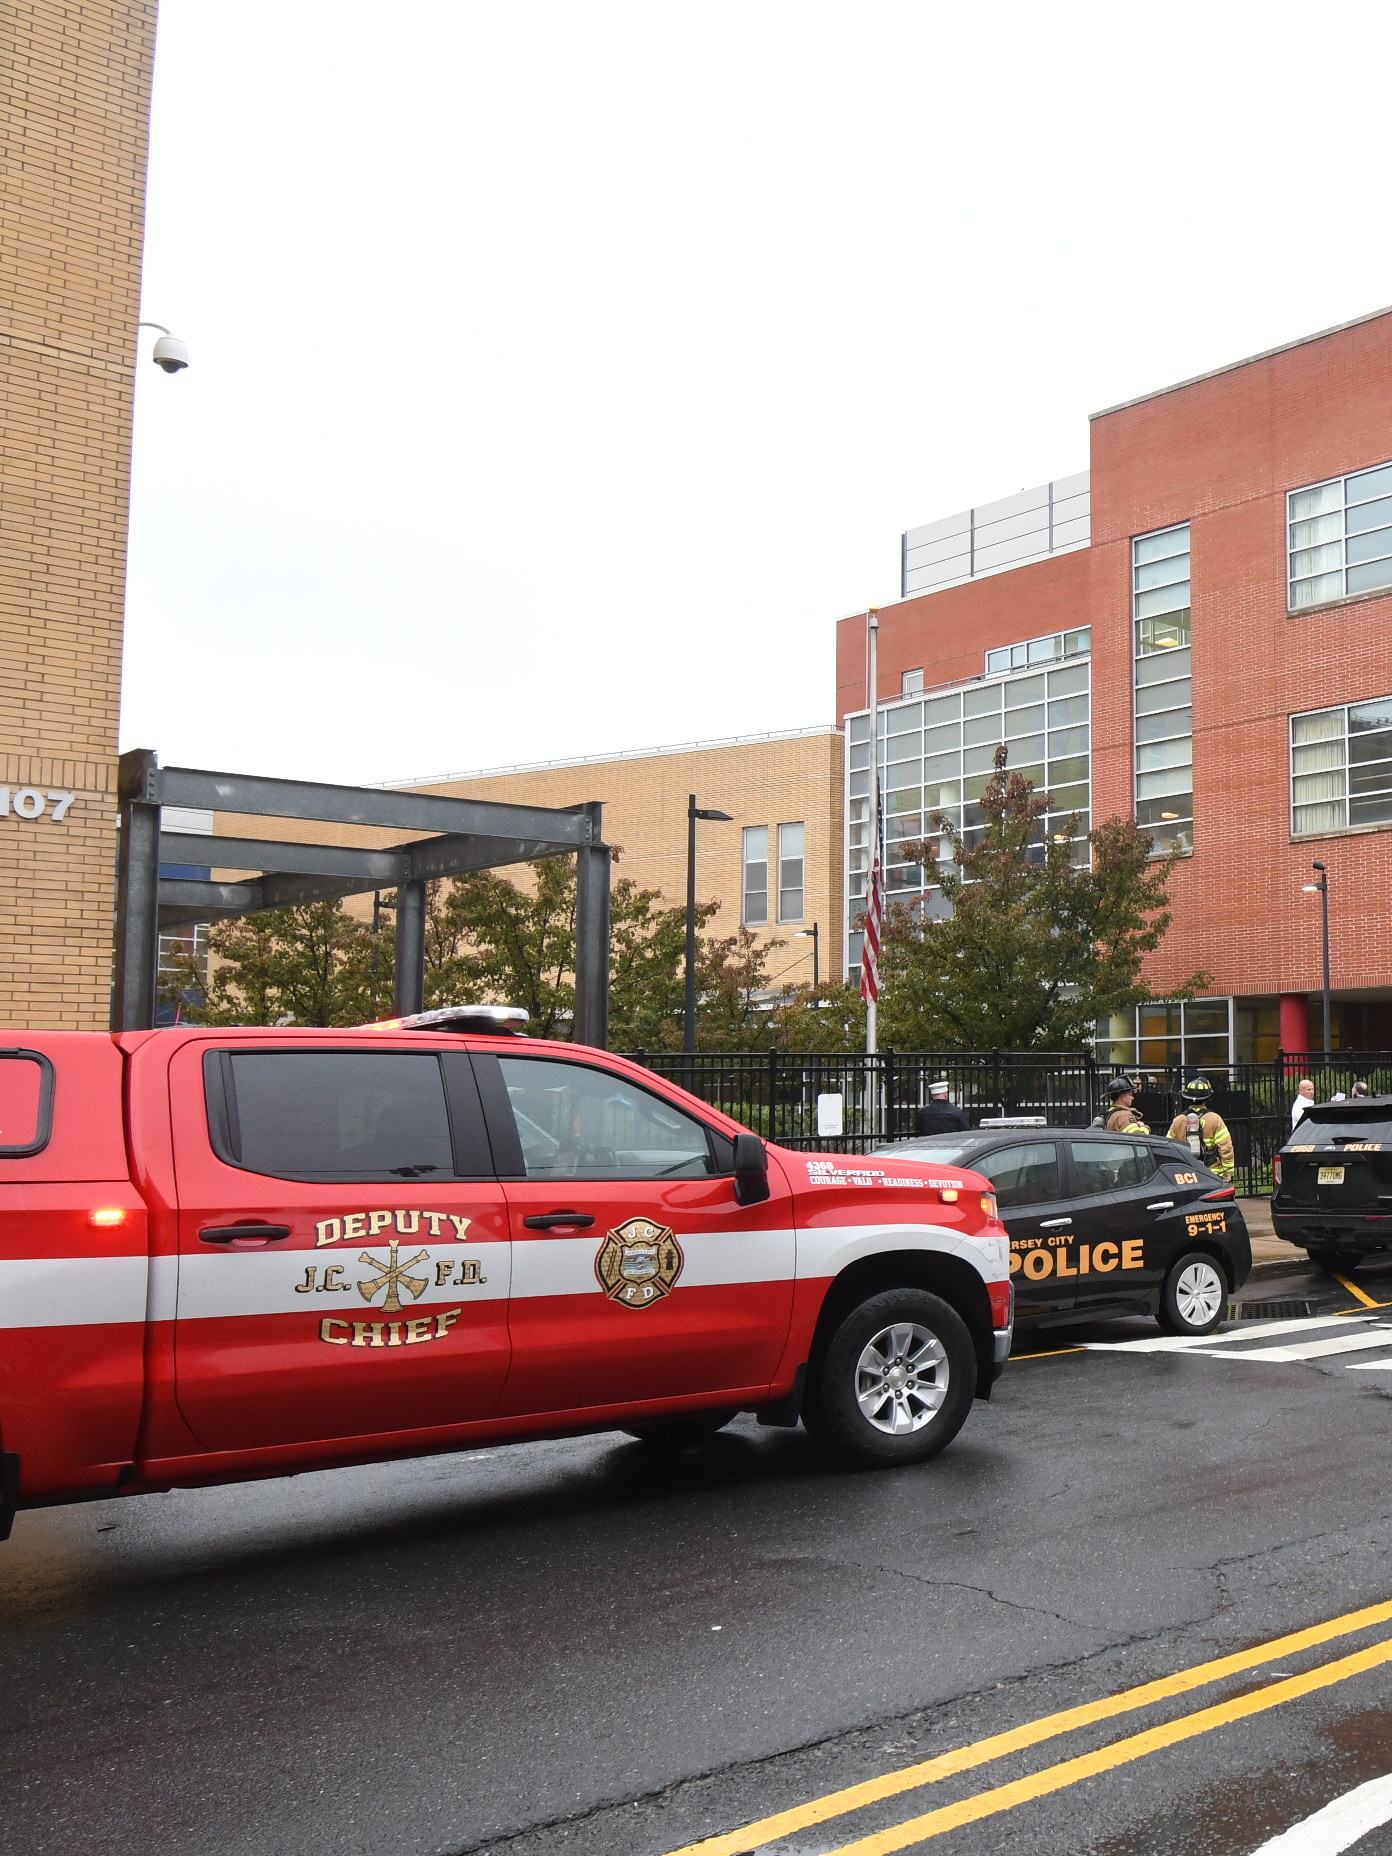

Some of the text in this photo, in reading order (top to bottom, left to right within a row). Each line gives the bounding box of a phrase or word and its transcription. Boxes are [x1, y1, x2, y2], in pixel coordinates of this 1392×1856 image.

[0, 787, 75, 820] 107
[1343, 1143, 1382, 1152] POLICE
[808, 1169, 885, 1177] SILVERADO
[1174, 1172, 1198, 1185] BCI
[809, 1176, 847, 1185] COURAGE
[882, 1178, 923, 1188] READINESS
[928, 1179, 963, 1189] DEVOTION
[1185, 1211, 1225, 1224] EMERGENCY
[315, 1209, 472, 1248] DEPUTY
[1187, 1220, 1227, 1237] 9-1-1
[1009, 1235, 1075, 1250] RSEY CITY
[294, 1259, 488, 1293] J.C. F.D.
[320, 1307, 462, 1348] CHIEF
